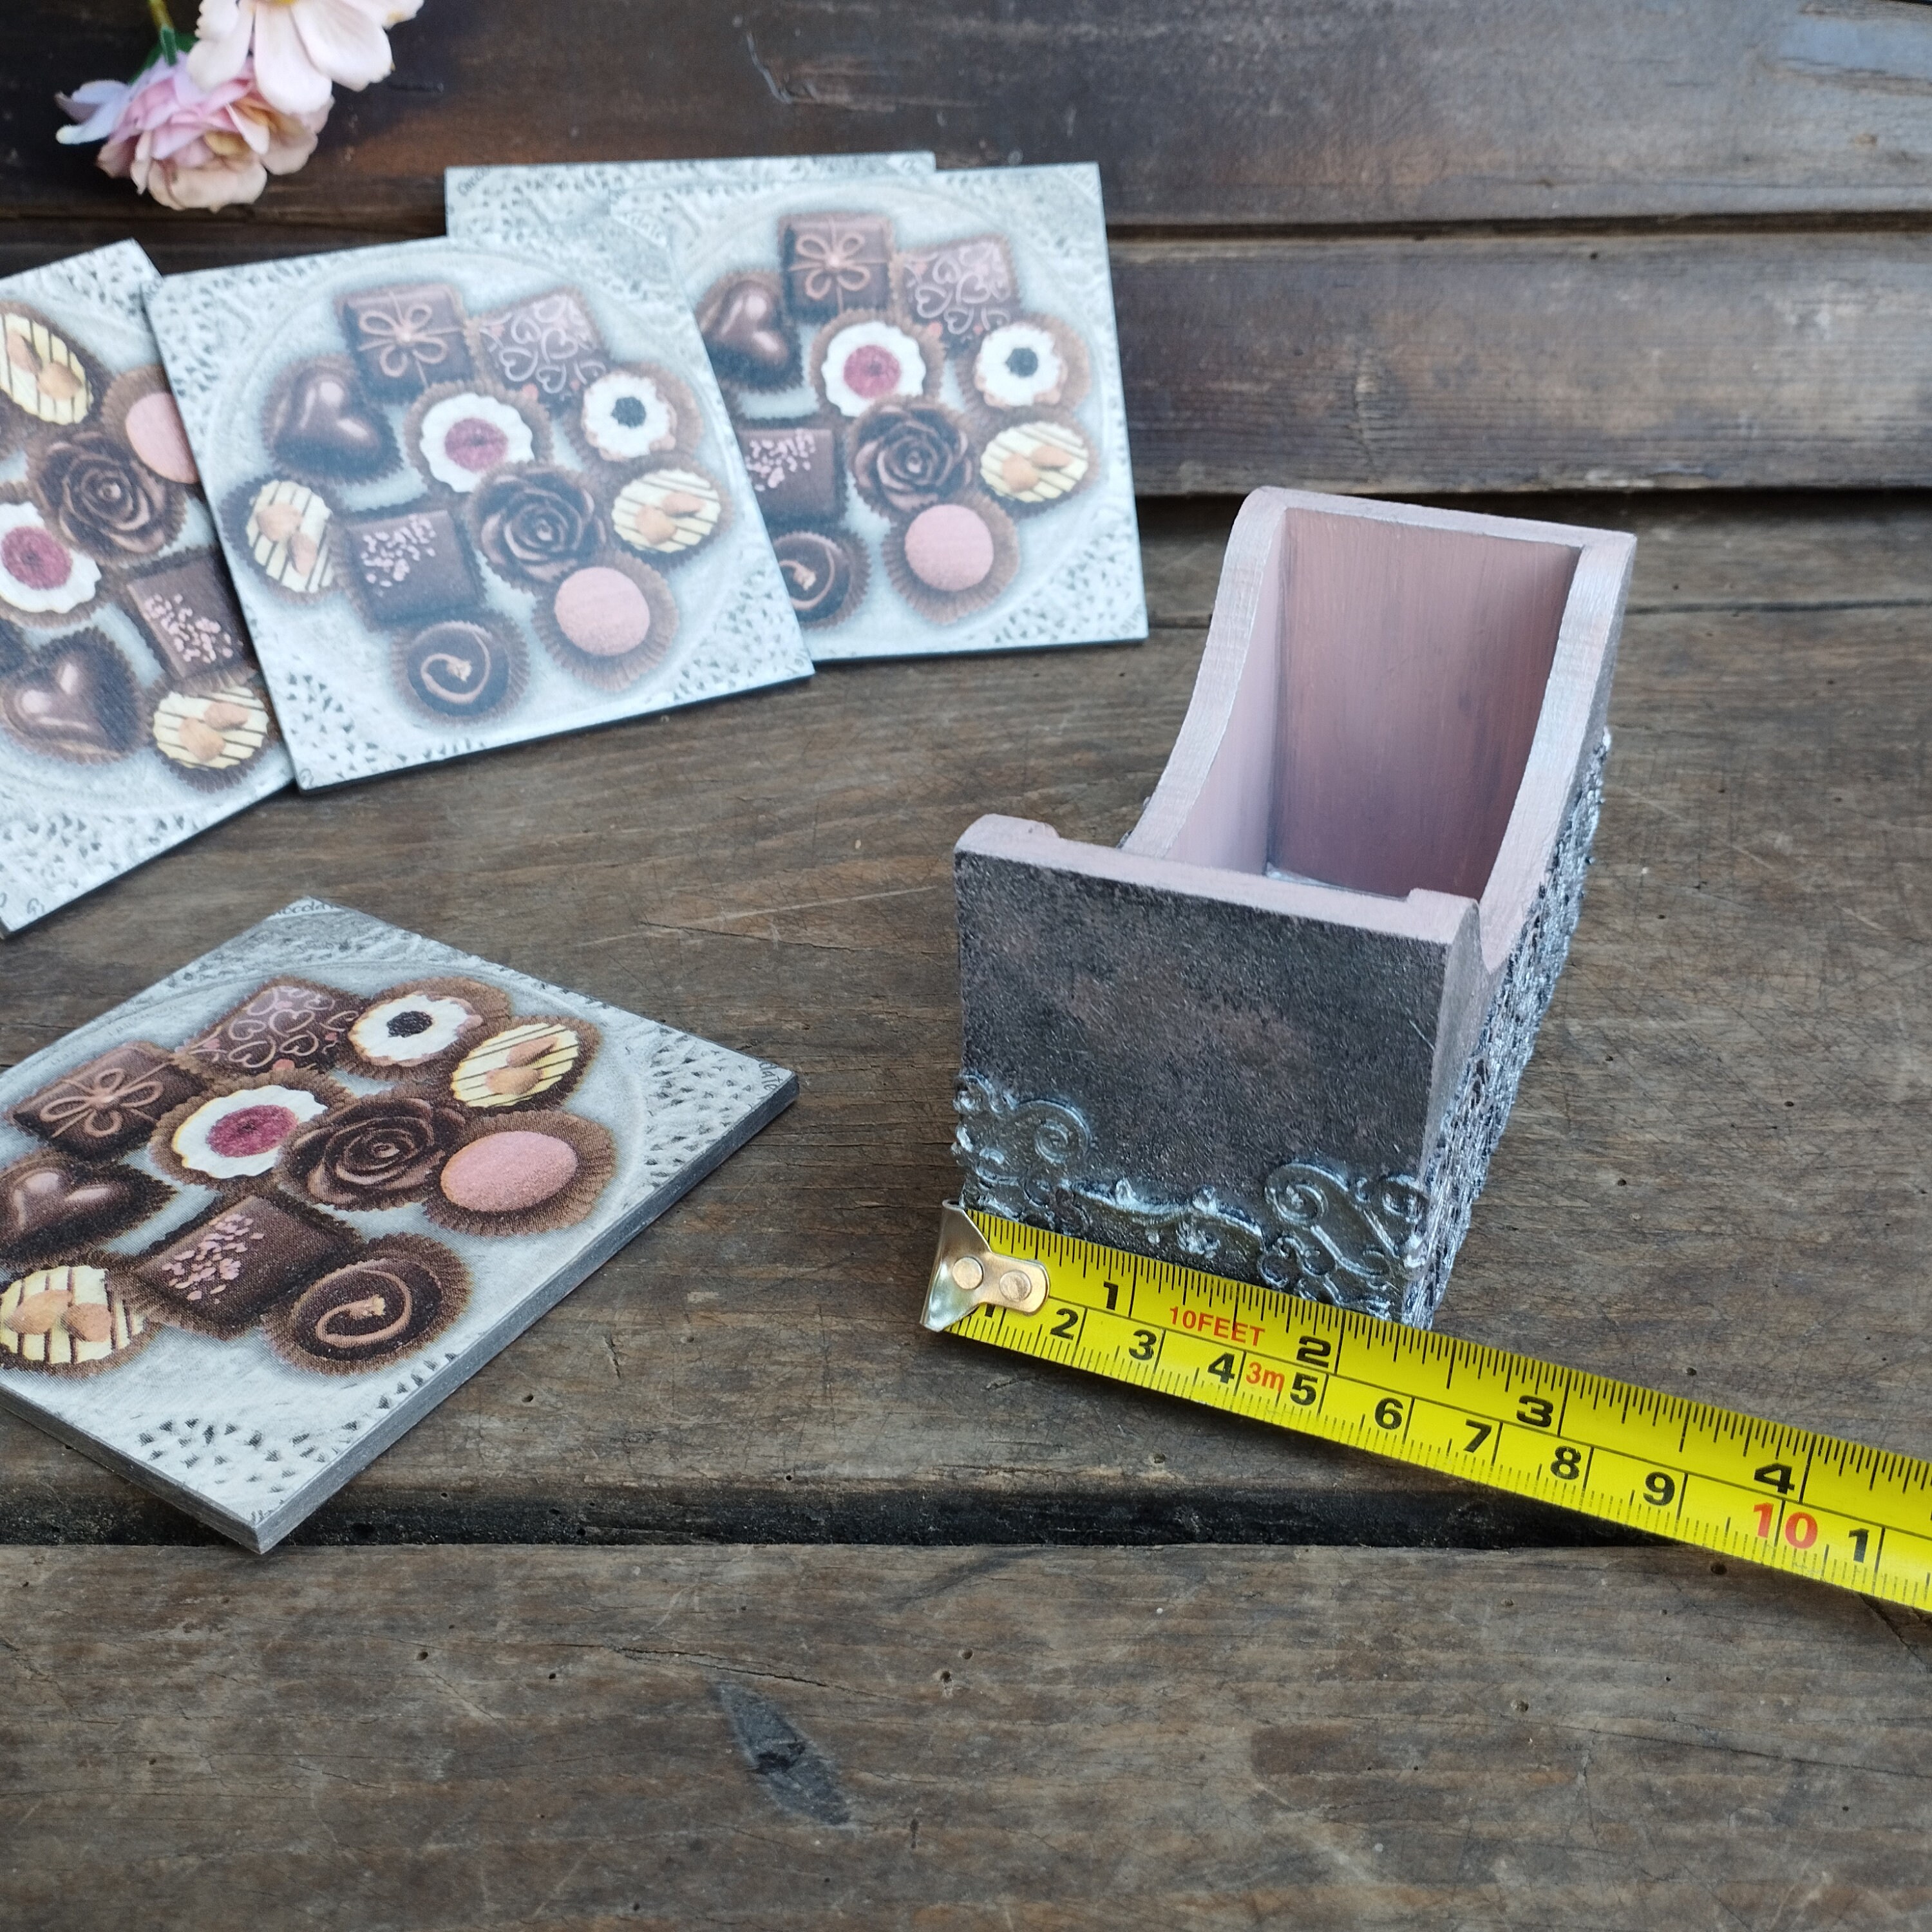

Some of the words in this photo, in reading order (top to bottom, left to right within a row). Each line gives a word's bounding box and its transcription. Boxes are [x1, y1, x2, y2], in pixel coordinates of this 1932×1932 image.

[1049, 1307, 1079, 1340] 2
[1128, 1329, 1157, 1361] 3
[1207, 1352, 1236, 1385] 4
[1246, 1361, 1285, 1392] 3m
[1289, 1372, 1318, 1406] 5
[1374, 1397, 1404, 1430] 6
[1464, 1419, 1493, 1454] 7
[1550, 1445, 1582, 1481] 8
[1643, 1471, 1676, 1506] 9
[1753, 1502, 1818, 1549] 10
[1848, 1528, 1870, 1563] 1
[1103, 1280, 1119, 1311] 1
[1169, 1306, 1265, 1347] 10FEET
[1295, 1335, 1332, 1369] 2
[1515, 1394, 1555, 1428] 3
[1753, 1463, 1796, 1495] 4
